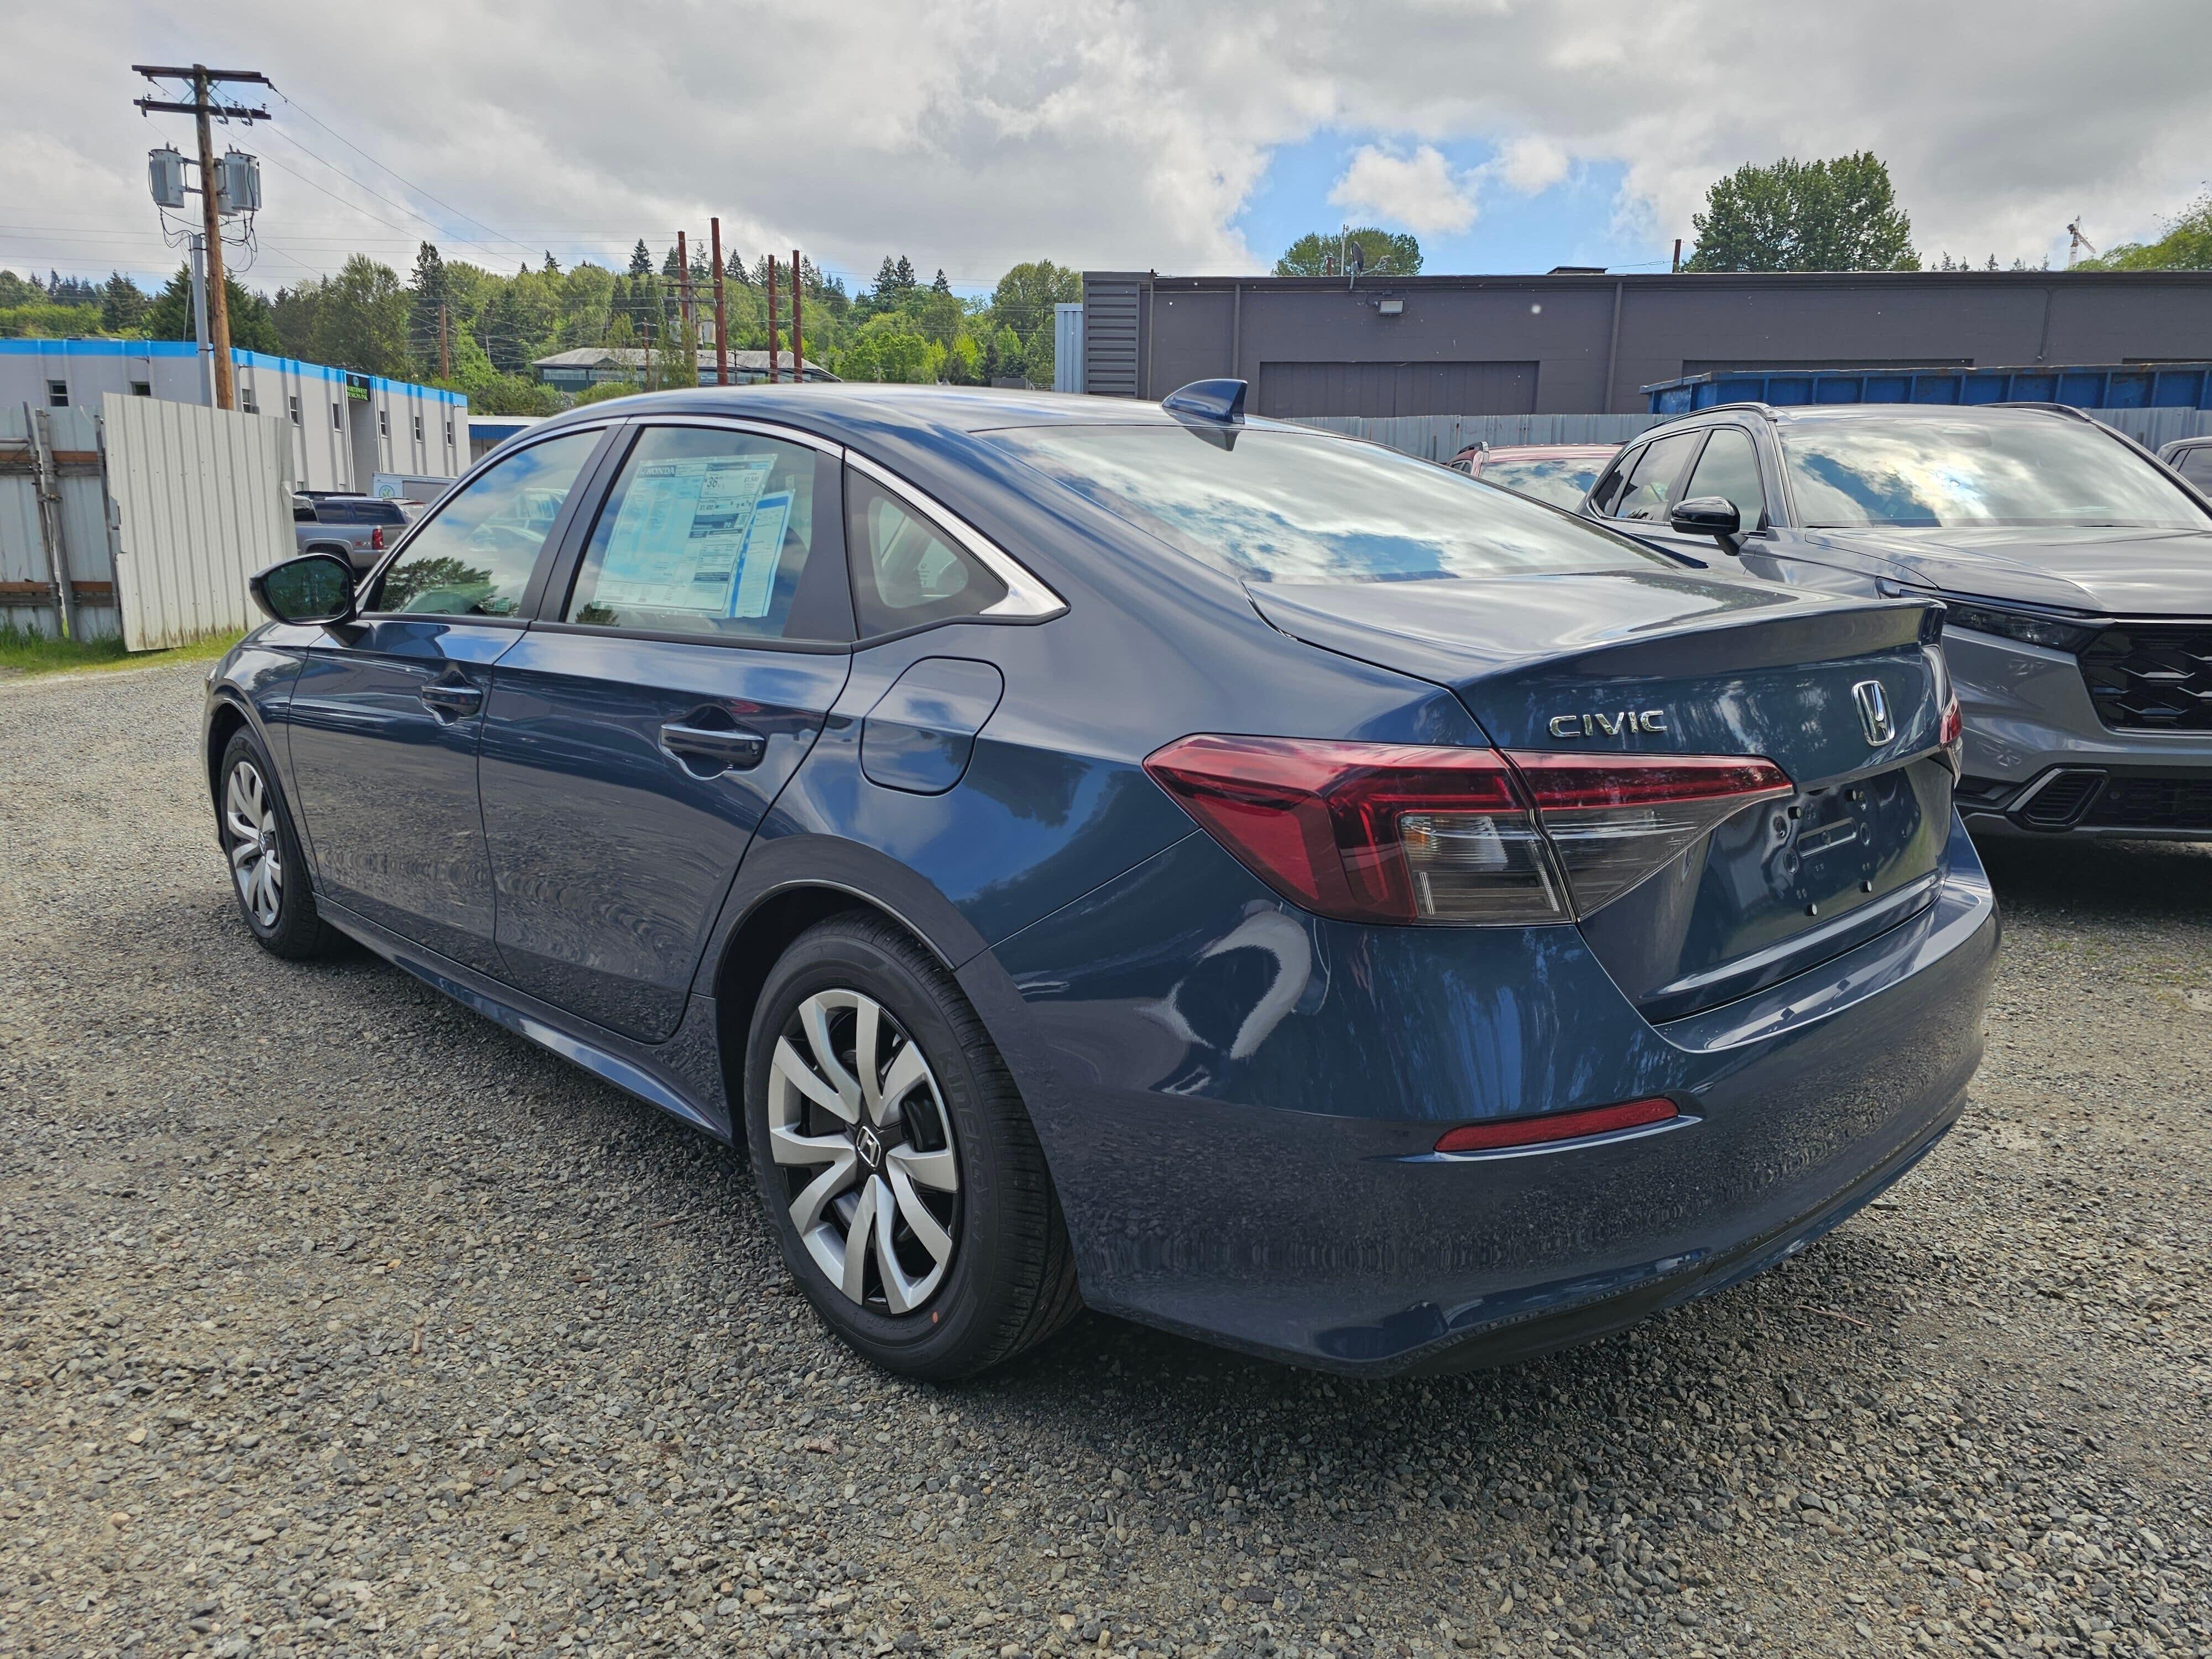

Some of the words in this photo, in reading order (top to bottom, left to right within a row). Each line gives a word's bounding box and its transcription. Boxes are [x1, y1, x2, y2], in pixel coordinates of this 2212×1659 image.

[646, 467, 675, 476] HONDA
[707, 477, 718, 488] 36
[1550, 710, 1667, 738] CIVIC
